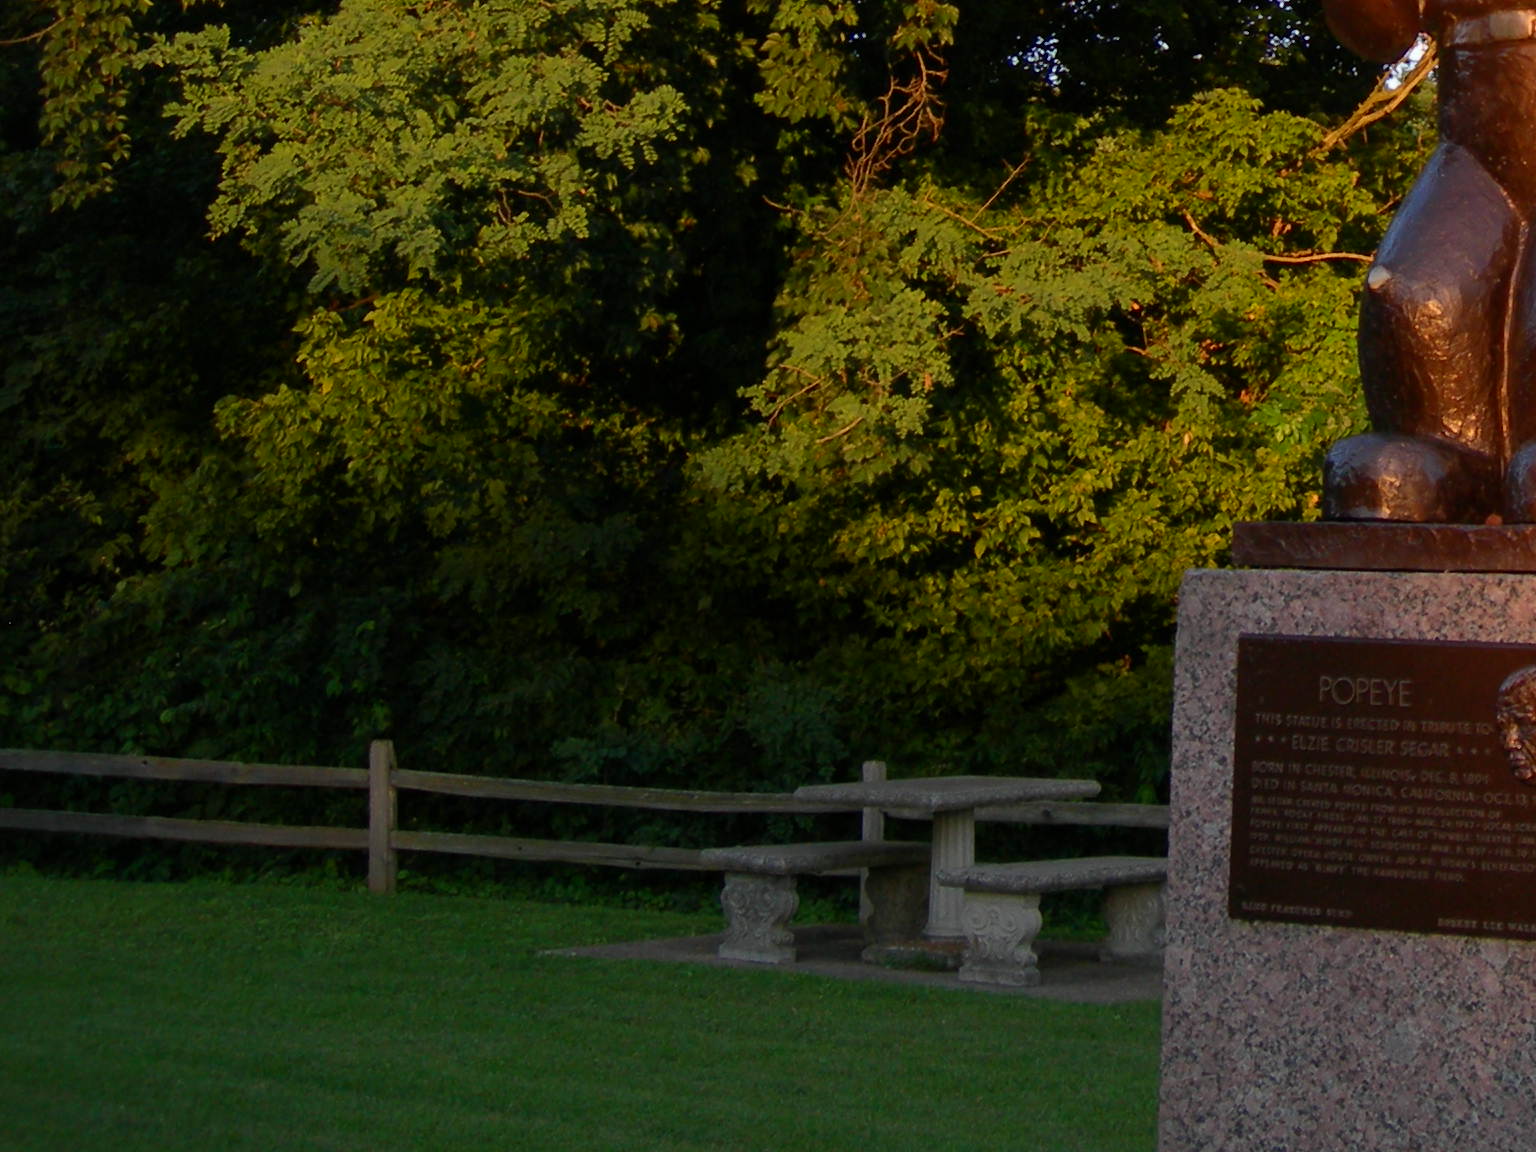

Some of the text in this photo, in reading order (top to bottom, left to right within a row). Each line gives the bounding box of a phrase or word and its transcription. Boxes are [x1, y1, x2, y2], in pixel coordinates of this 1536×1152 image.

[1319, 676, 1413, 707] POPEYE
[1255, 712, 1282, 726] THIS
[1286, 714, 1326, 729] STATUE
[1331, 716, 1341, 729] IS
[1347, 717, 1400, 732] ERECTED
[1403, 719, 1416, 732] IN
[1422, 720, 1472, 734] TRIBUTE
[1291, 735, 1449, 758] ELZIE CRISLER SEGAR
[1251, 760, 1284, 774] BORN
[1288, 763, 1301, 775] IN
[1251, 777, 1279, 790] DIED
[1283, 779, 1296, 791] IN
[1300, 780, 1339, 794] SANTA
